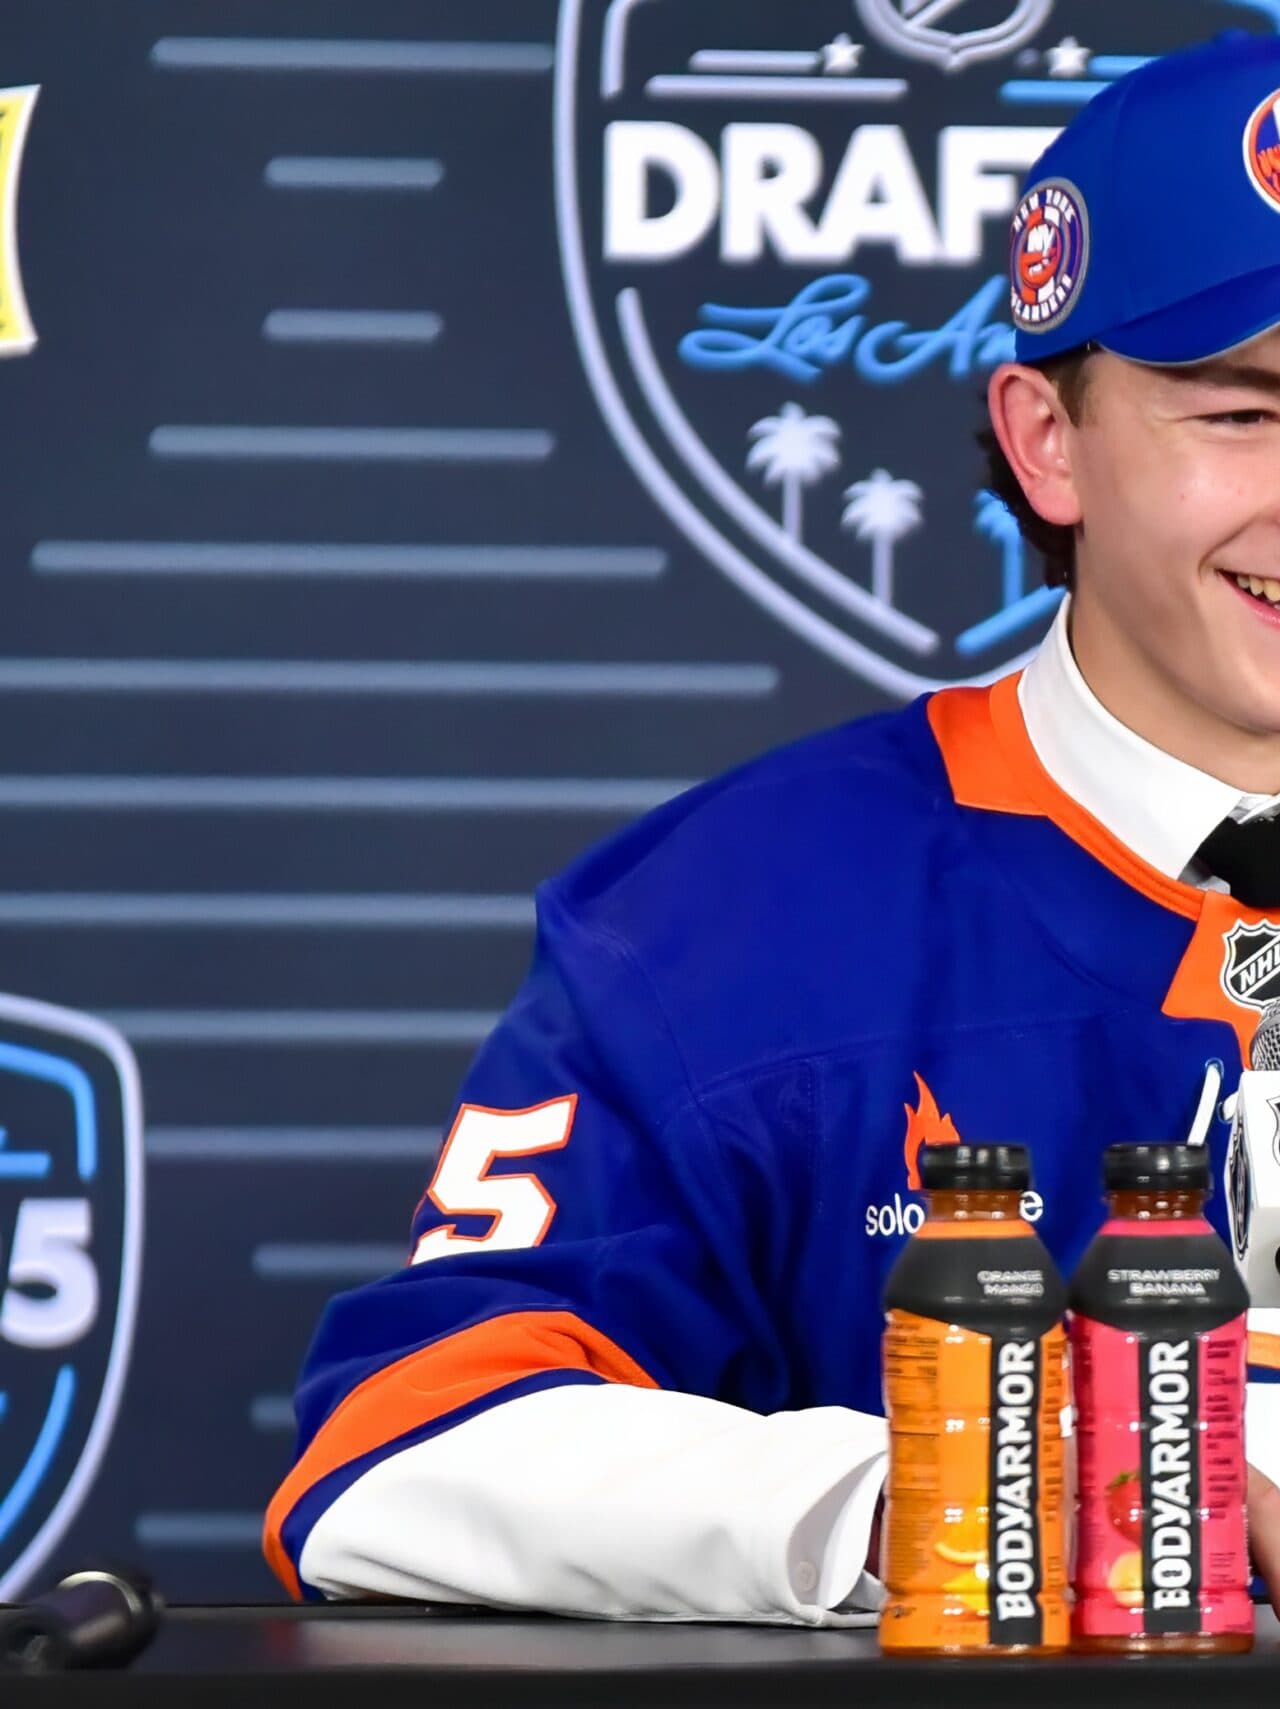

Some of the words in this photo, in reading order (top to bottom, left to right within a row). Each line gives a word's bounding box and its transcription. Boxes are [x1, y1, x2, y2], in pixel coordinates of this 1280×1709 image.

[603, 120, 1064, 262] DRAF
[1011, 274, 1072, 321] SLANDERS
[407, 1092, 578, 1267] 5
[865, 1192, 926, 1237] solo
[0, 1196, 100, 1350] 5
[1107, 1267, 1220, 1283] STRAWBERRY
[1129, 1280, 1207, 1296] BANANA
[995, 1339, 1036, 1621] BODYARMOR
[1148, 1338, 1192, 1611] BODYARMOR
